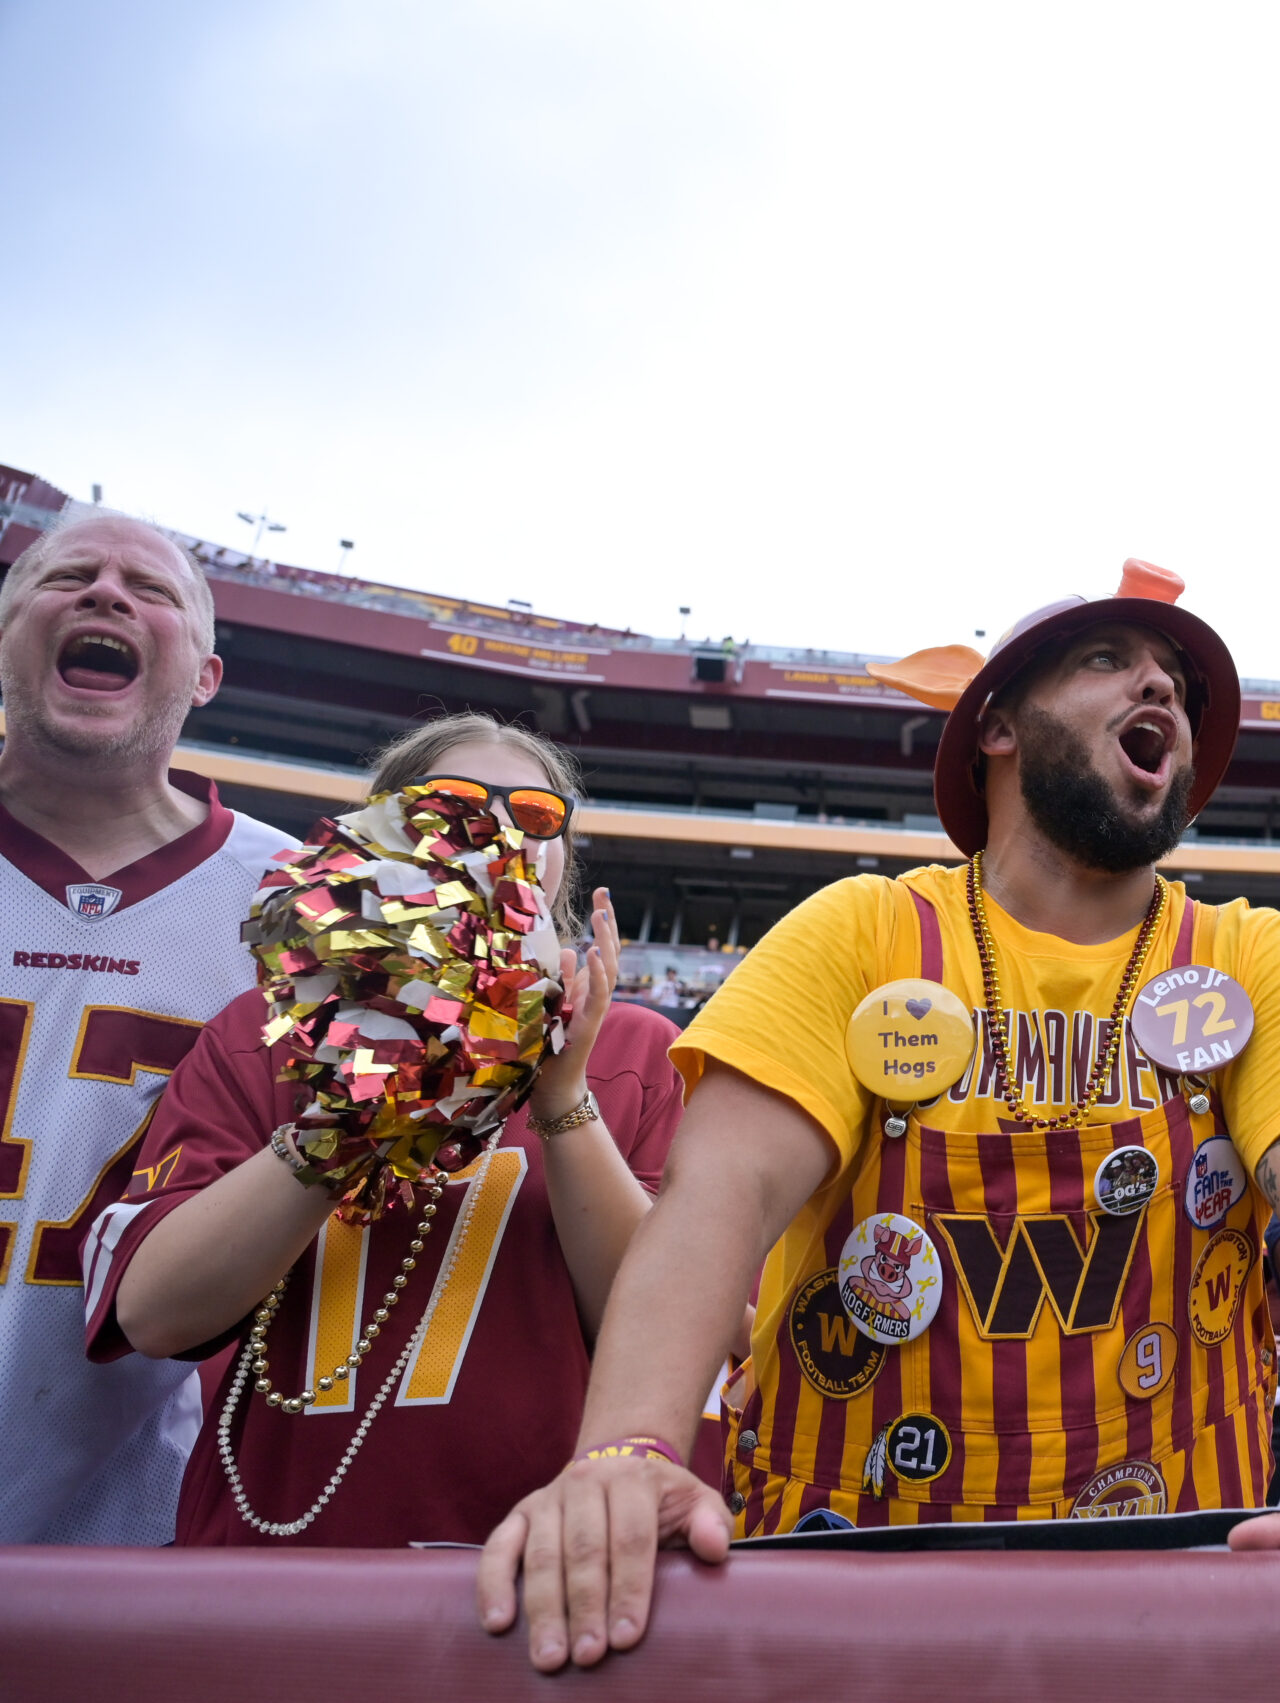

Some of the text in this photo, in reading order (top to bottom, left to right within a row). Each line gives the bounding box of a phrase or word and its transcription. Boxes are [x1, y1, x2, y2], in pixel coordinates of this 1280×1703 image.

[446, 633, 478, 656] 40
[72, 887, 117, 899] EQUIPMENT
[81, 903, 102, 915] NFL
[13, 950, 141, 976] REDSKINS
[1138, 967, 1231, 1008] Leno Jr
[883, 1000, 889, 1016] I
[1155, 991, 1237, 1047] 72
[877, 1030, 938, 1049] Them
[883, 1058, 937, 1079] Hogs
[1176, 1039, 1235, 1073] FAN
[1113, 1181, 1148, 1201] OG's
[1194, 1170, 1220, 1205] FAN
[1220, 1176, 1234, 1188] THE
[1195, 1187, 1232, 1225] YEAR
[931, 1201, 1151, 1341] W
[1192, 1233, 1248, 1289] WASHINGTON
[842, 1285, 863, 1316] HOG
[1205, 1264, 1232, 1312] W
[816, 1311, 859, 1358] W
[1192, 1312, 1229, 1341] FOOTBALL
[798, 1340, 880, 1392] FOOTBALL TEAM
[1136, 1331, 1163, 1390] 9
[894, 1426, 937, 1472] 21
[1088, 1466, 1156, 1497] CHAMPIONS
